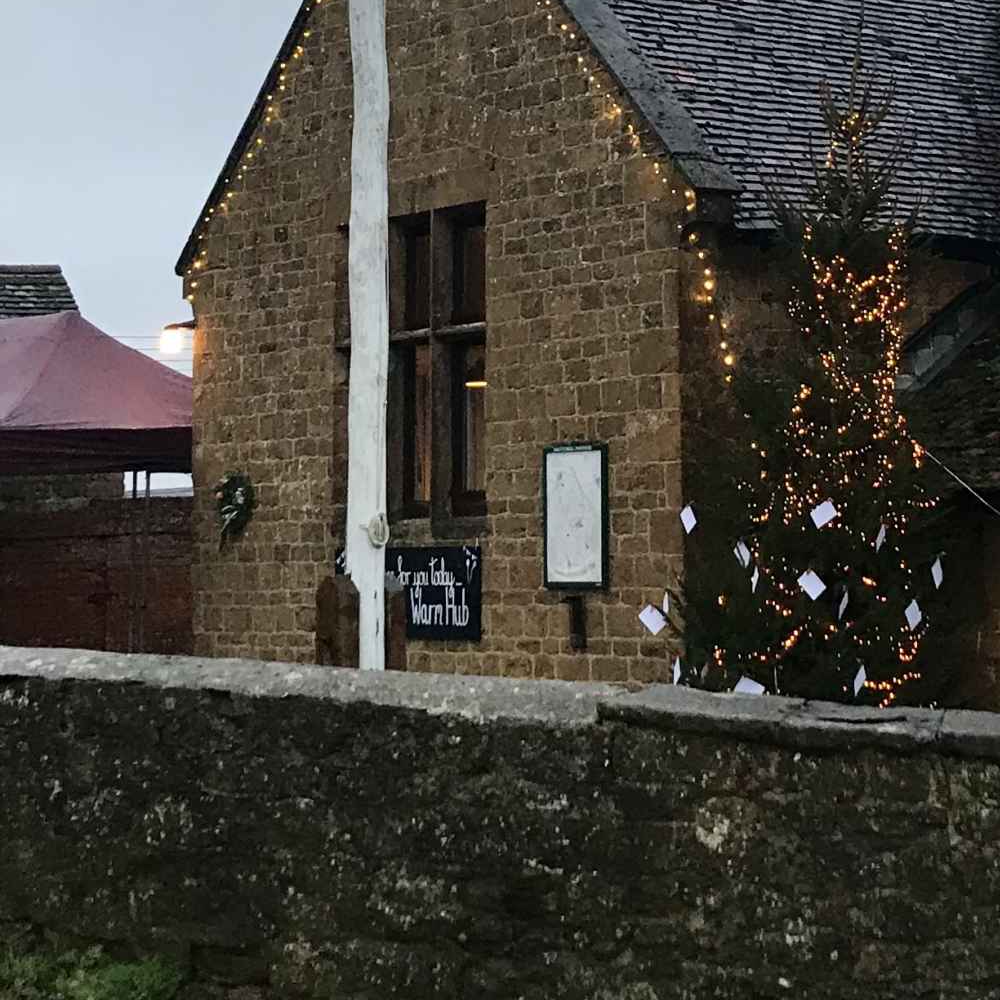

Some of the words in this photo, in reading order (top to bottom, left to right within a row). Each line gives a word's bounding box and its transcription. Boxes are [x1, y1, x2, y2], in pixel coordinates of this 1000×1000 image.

[395, 555, 411, 586] for
[412, 570, 429, 598] you
[410, 587, 444, 626] Warm
[445, 587, 469, 627] Hub
